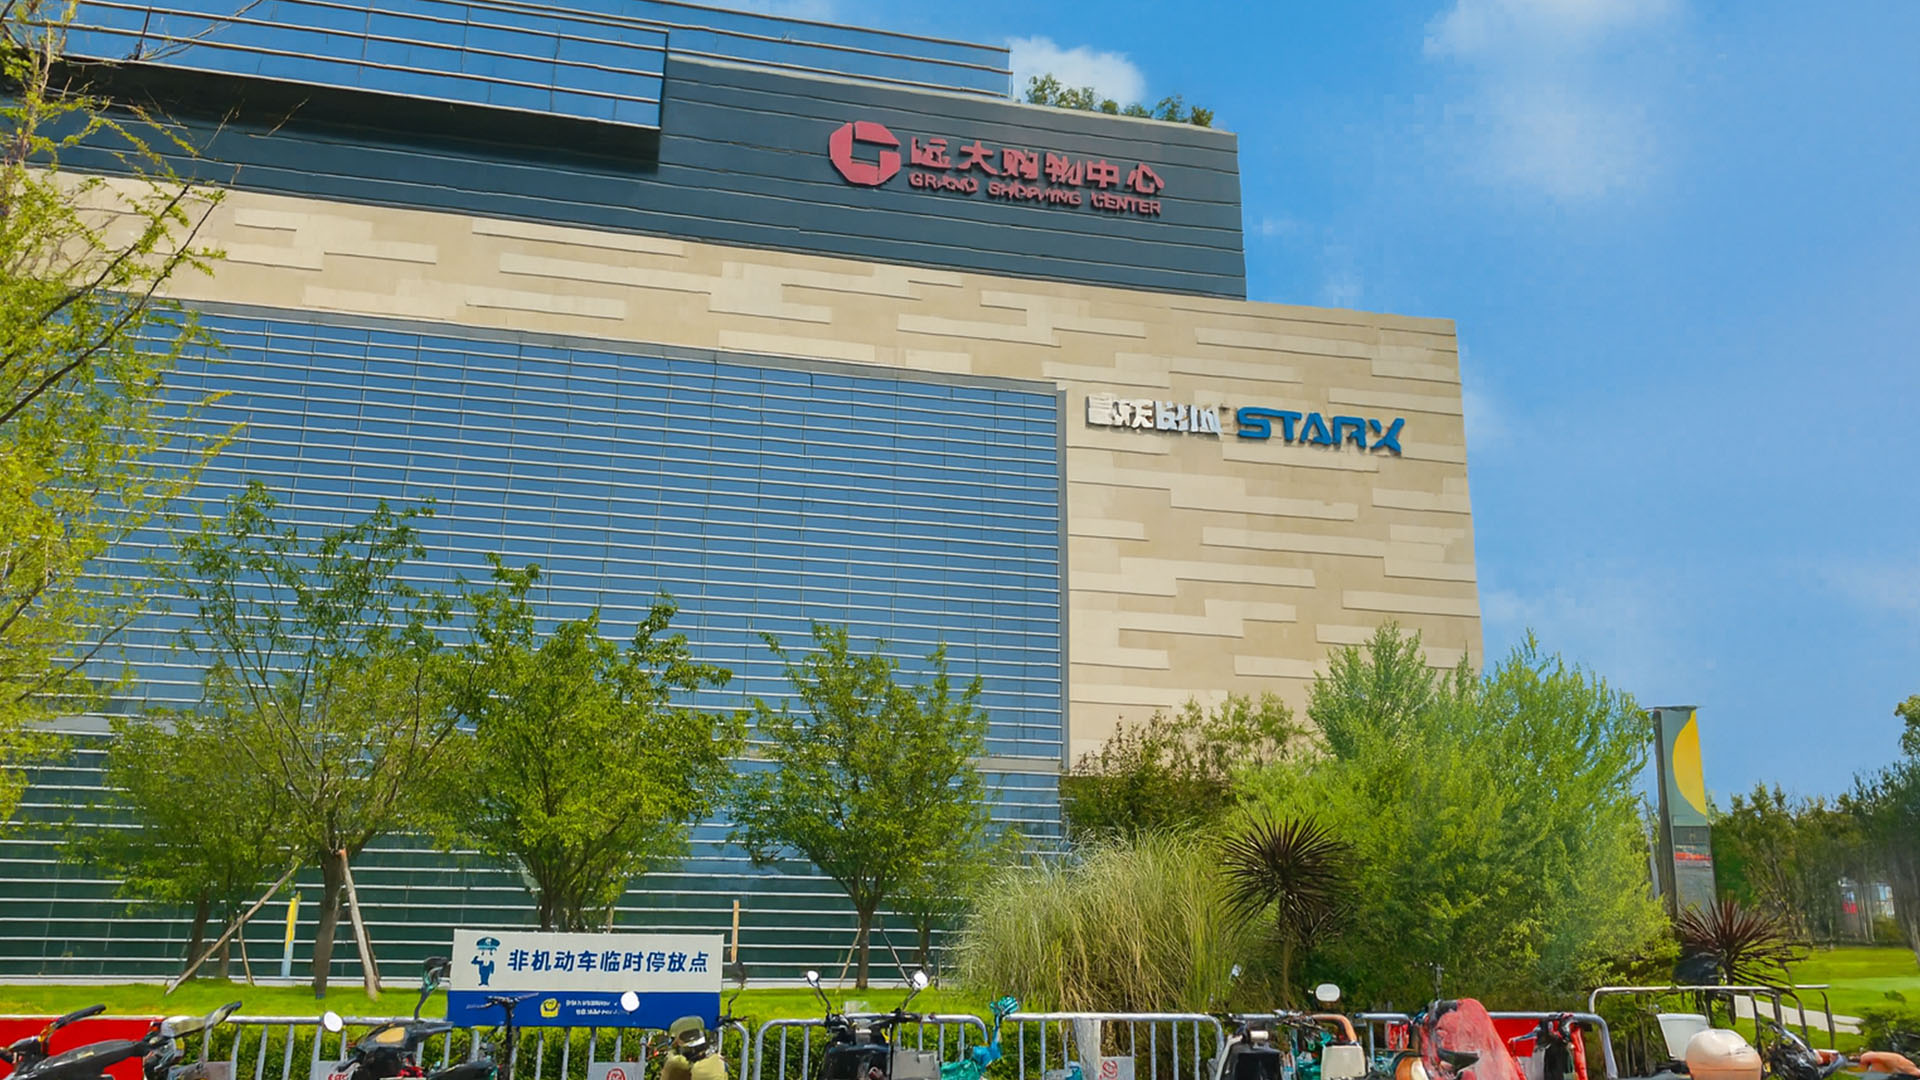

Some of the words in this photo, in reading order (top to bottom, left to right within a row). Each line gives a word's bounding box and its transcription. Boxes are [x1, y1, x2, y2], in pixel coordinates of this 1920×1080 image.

[910, 136, 1165, 194] 远大购物中心
[909, 172, 979, 193] GRAND
[1091, 191, 1161, 214] CENTER
[1237, 406, 1405, 454] STARX
[507, 949, 709, 973] 非机动车临时停放点
